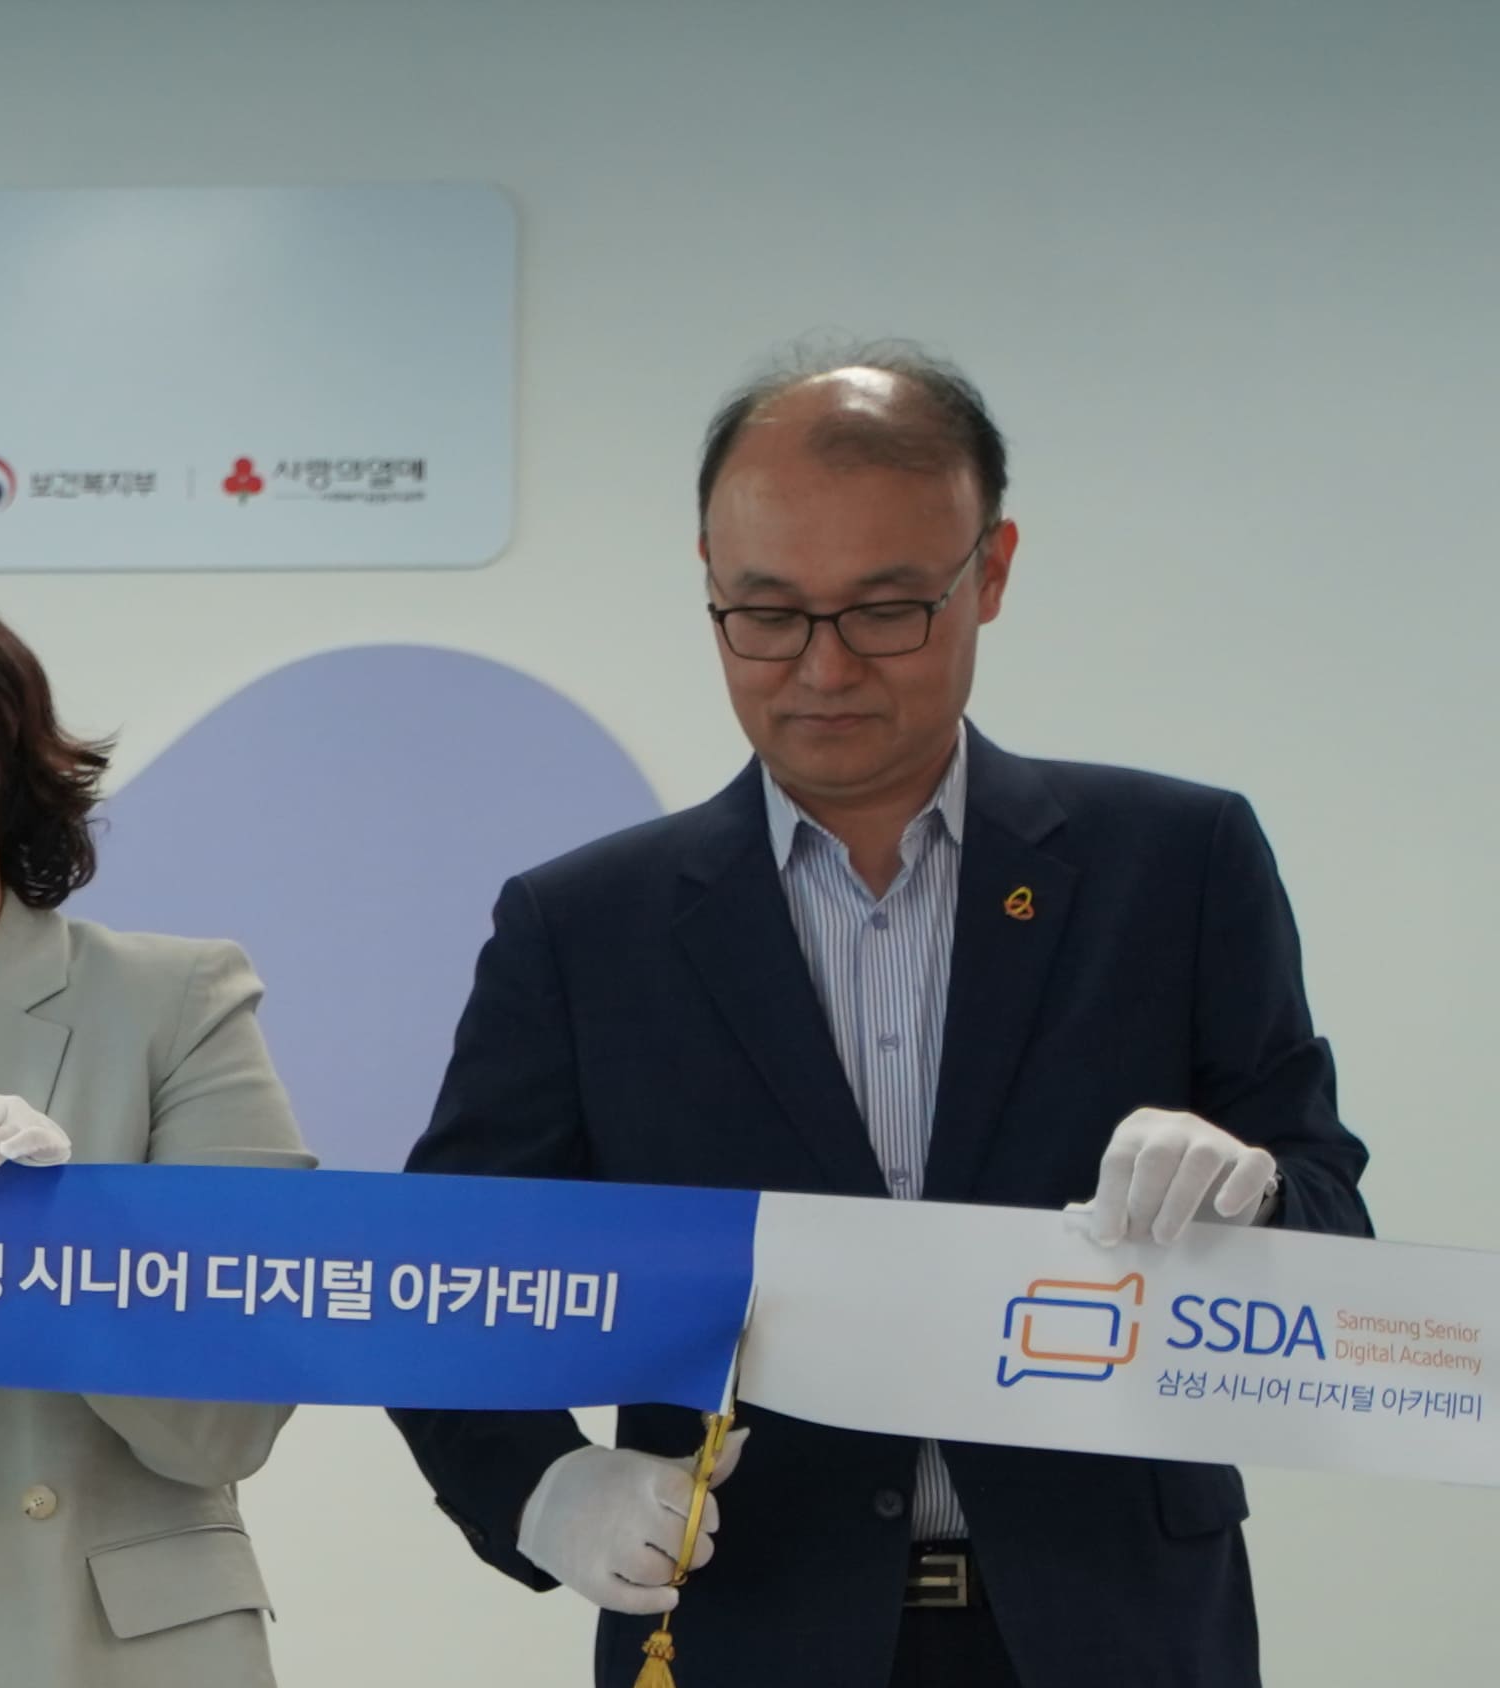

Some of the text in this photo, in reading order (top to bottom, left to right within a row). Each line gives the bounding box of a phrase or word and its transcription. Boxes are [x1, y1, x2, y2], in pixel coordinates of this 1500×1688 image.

[19, 1246, 188, 1312] 시니어
[206, 1254, 372, 1321] 디지털
[389, 1263, 618, 1332] 아카데미
[1167, 1294, 1326, 1361] SSDA
[1336, 1310, 1481, 1343] Samsung Senior
[1335, 1339, 1482, 1375] Digital Academy
[1156, 1369, 1482, 1422] 삼성 시니어 디지털 아카데미
